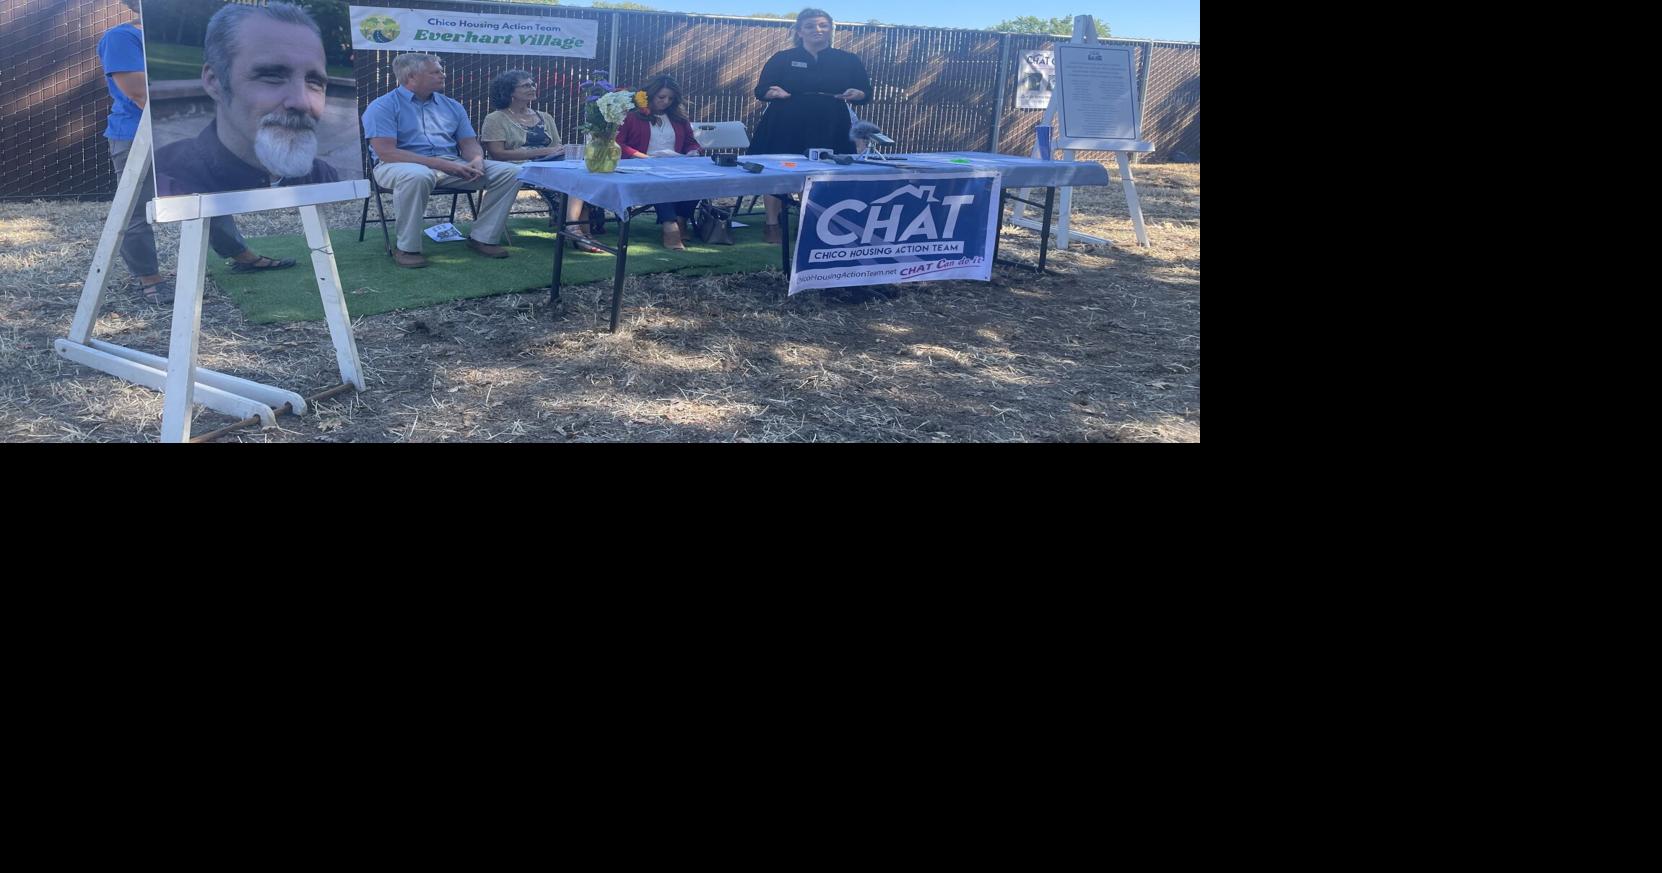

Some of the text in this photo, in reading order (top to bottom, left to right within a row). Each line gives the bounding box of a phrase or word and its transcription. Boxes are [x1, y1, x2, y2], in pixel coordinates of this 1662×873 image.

[427, 18, 561, 32] Chico Housing Action Team
[413, 29, 585, 49] Everhart Village
[1026, 55, 1050, 65] CHAT
[816, 194, 975, 245] CHAT
[814, 244, 959, 260] CHICO HOUSING ACTION TEAM
[900, 262, 934, 276] CHAT
[936, 258, 955, 269] Can
[958, 255, 970, 266] do
